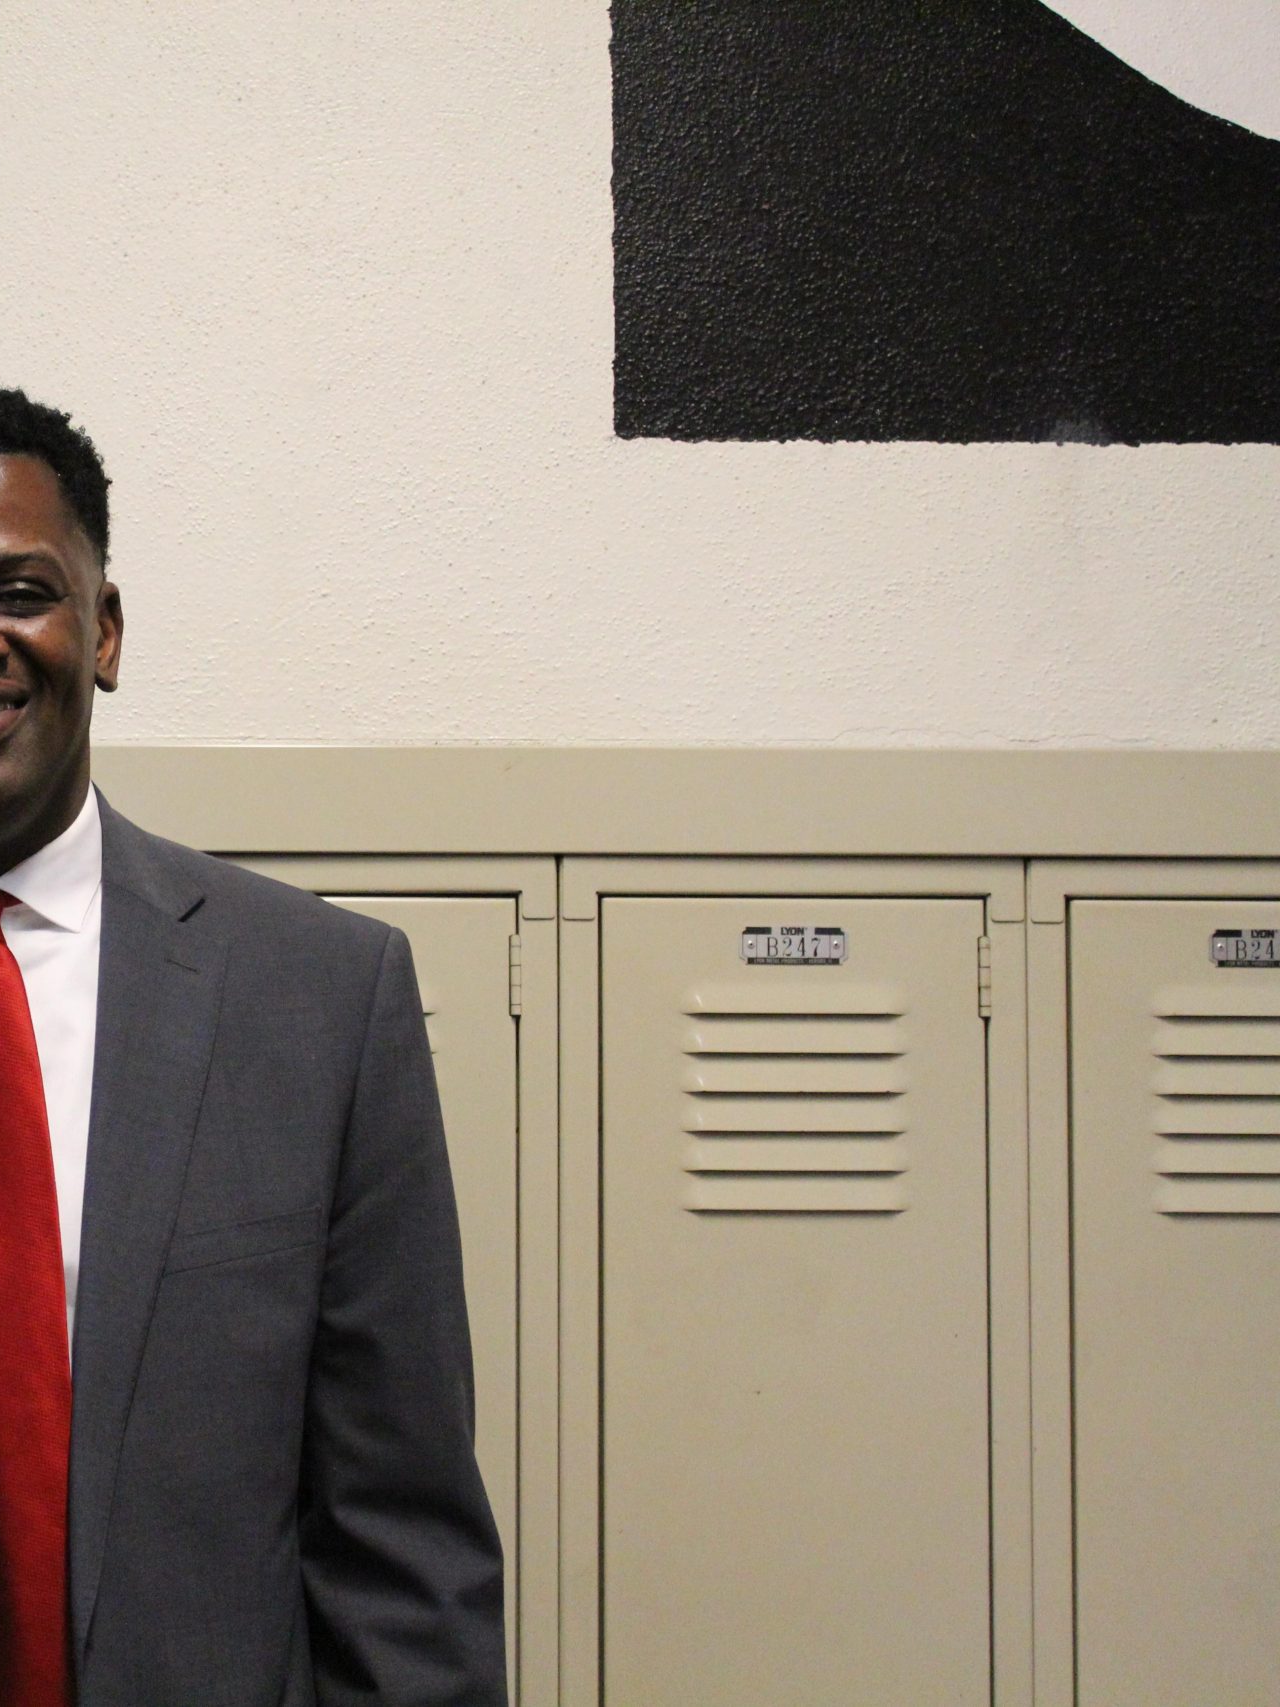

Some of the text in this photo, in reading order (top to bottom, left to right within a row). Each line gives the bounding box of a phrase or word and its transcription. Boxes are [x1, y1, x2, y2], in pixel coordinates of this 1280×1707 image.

[781, 927, 804, 936] LYON
[1251, 929, 1274, 938] LYON
[767, 937, 821, 957] B247
[1236, 939, 1276, 960] B24
